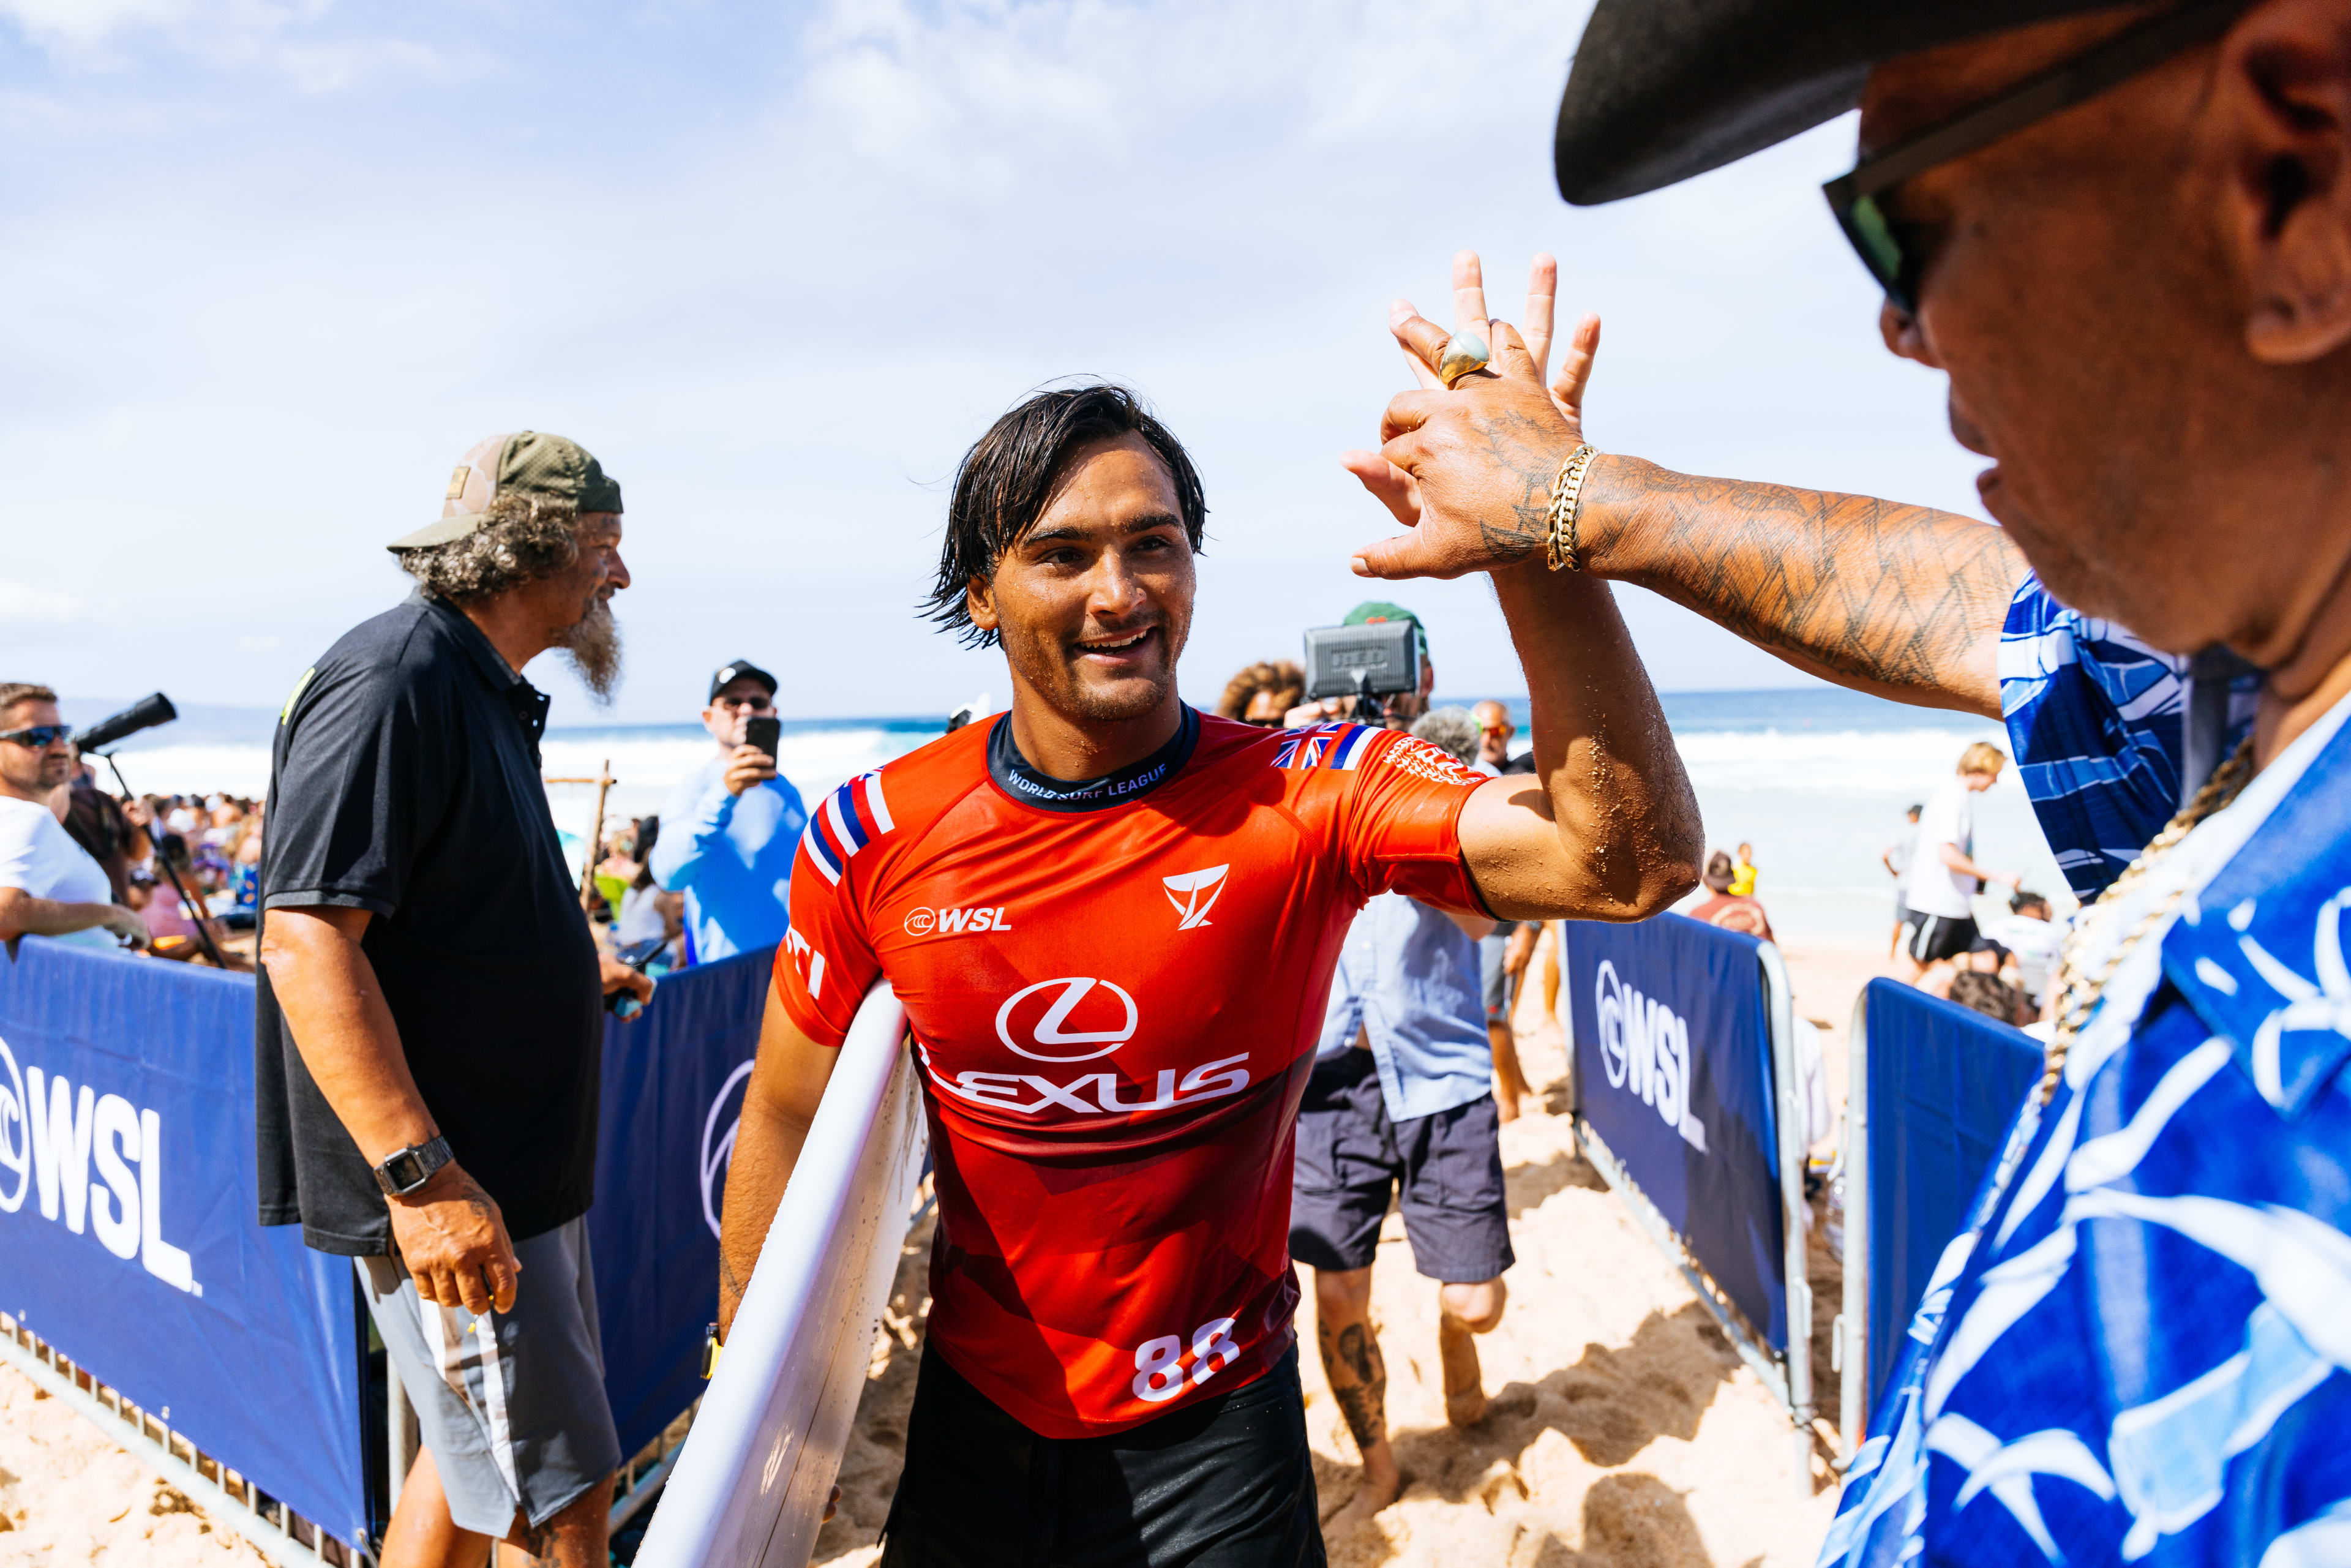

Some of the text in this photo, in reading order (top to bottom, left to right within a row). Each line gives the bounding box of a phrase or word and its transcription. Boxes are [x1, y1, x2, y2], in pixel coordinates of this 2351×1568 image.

[1008, 769, 1057, 800] WORLD
[939, 907, 1012, 932] WSL
[919, 1041, 1250, 1114] LEXUS
[1622, 982, 1706, 1152] WSL
[26, 1065, 193, 1293] WSL
[1132, 1318, 1240, 1402] 88
